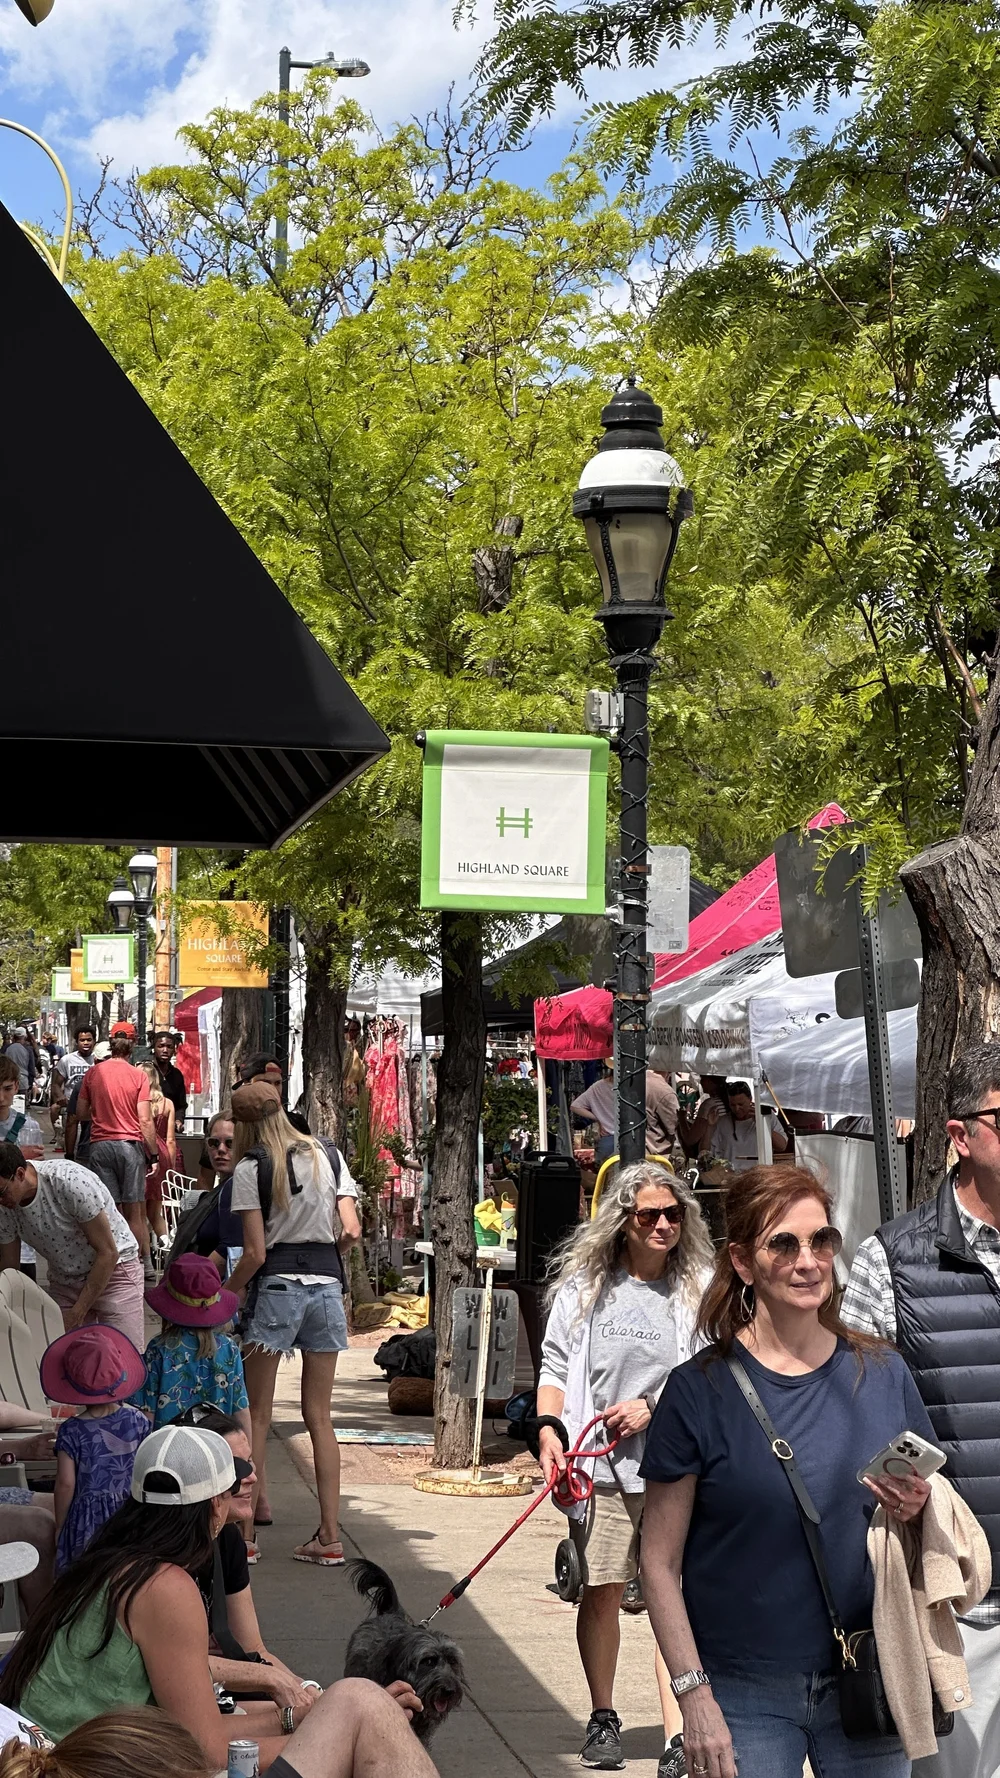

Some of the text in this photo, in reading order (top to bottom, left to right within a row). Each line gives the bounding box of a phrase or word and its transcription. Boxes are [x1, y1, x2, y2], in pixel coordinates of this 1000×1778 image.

[458, 862, 570, 876] HIGHLAND SQUARE
[188, 938, 240, 951] HIGHLA
[205, 954, 242, 963] SQUARE
[598, 1320, 662, 1341] Colorado
